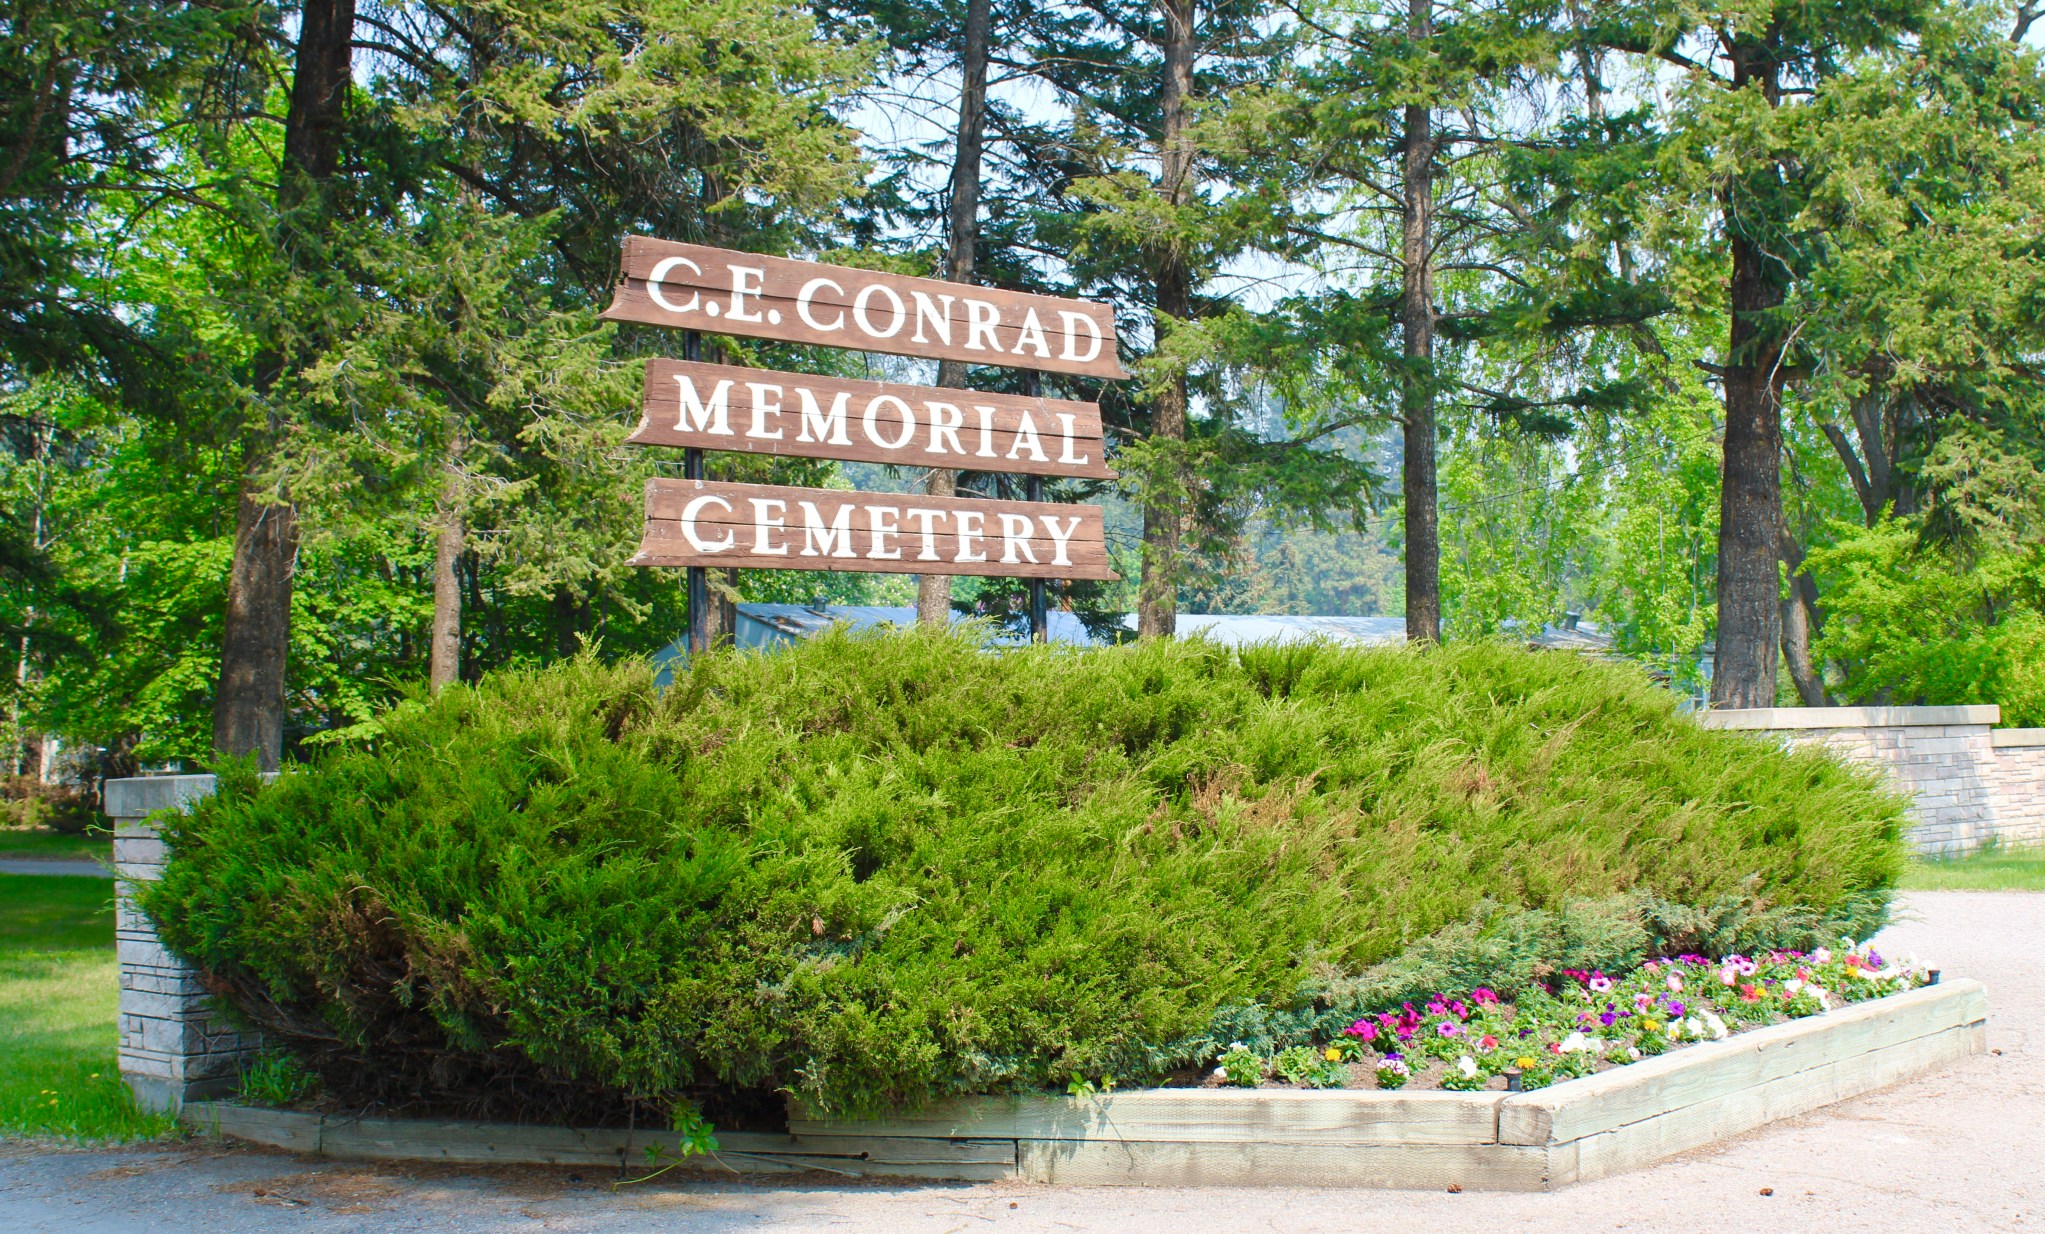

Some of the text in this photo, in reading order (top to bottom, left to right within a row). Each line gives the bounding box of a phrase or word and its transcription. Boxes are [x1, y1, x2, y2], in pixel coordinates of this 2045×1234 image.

[647, 256, 1103, 362] C.E. CONRAD
[673, 374, 1089, 465] MEMORIAL
[681, 495, 1082, 567] CEMETERY
